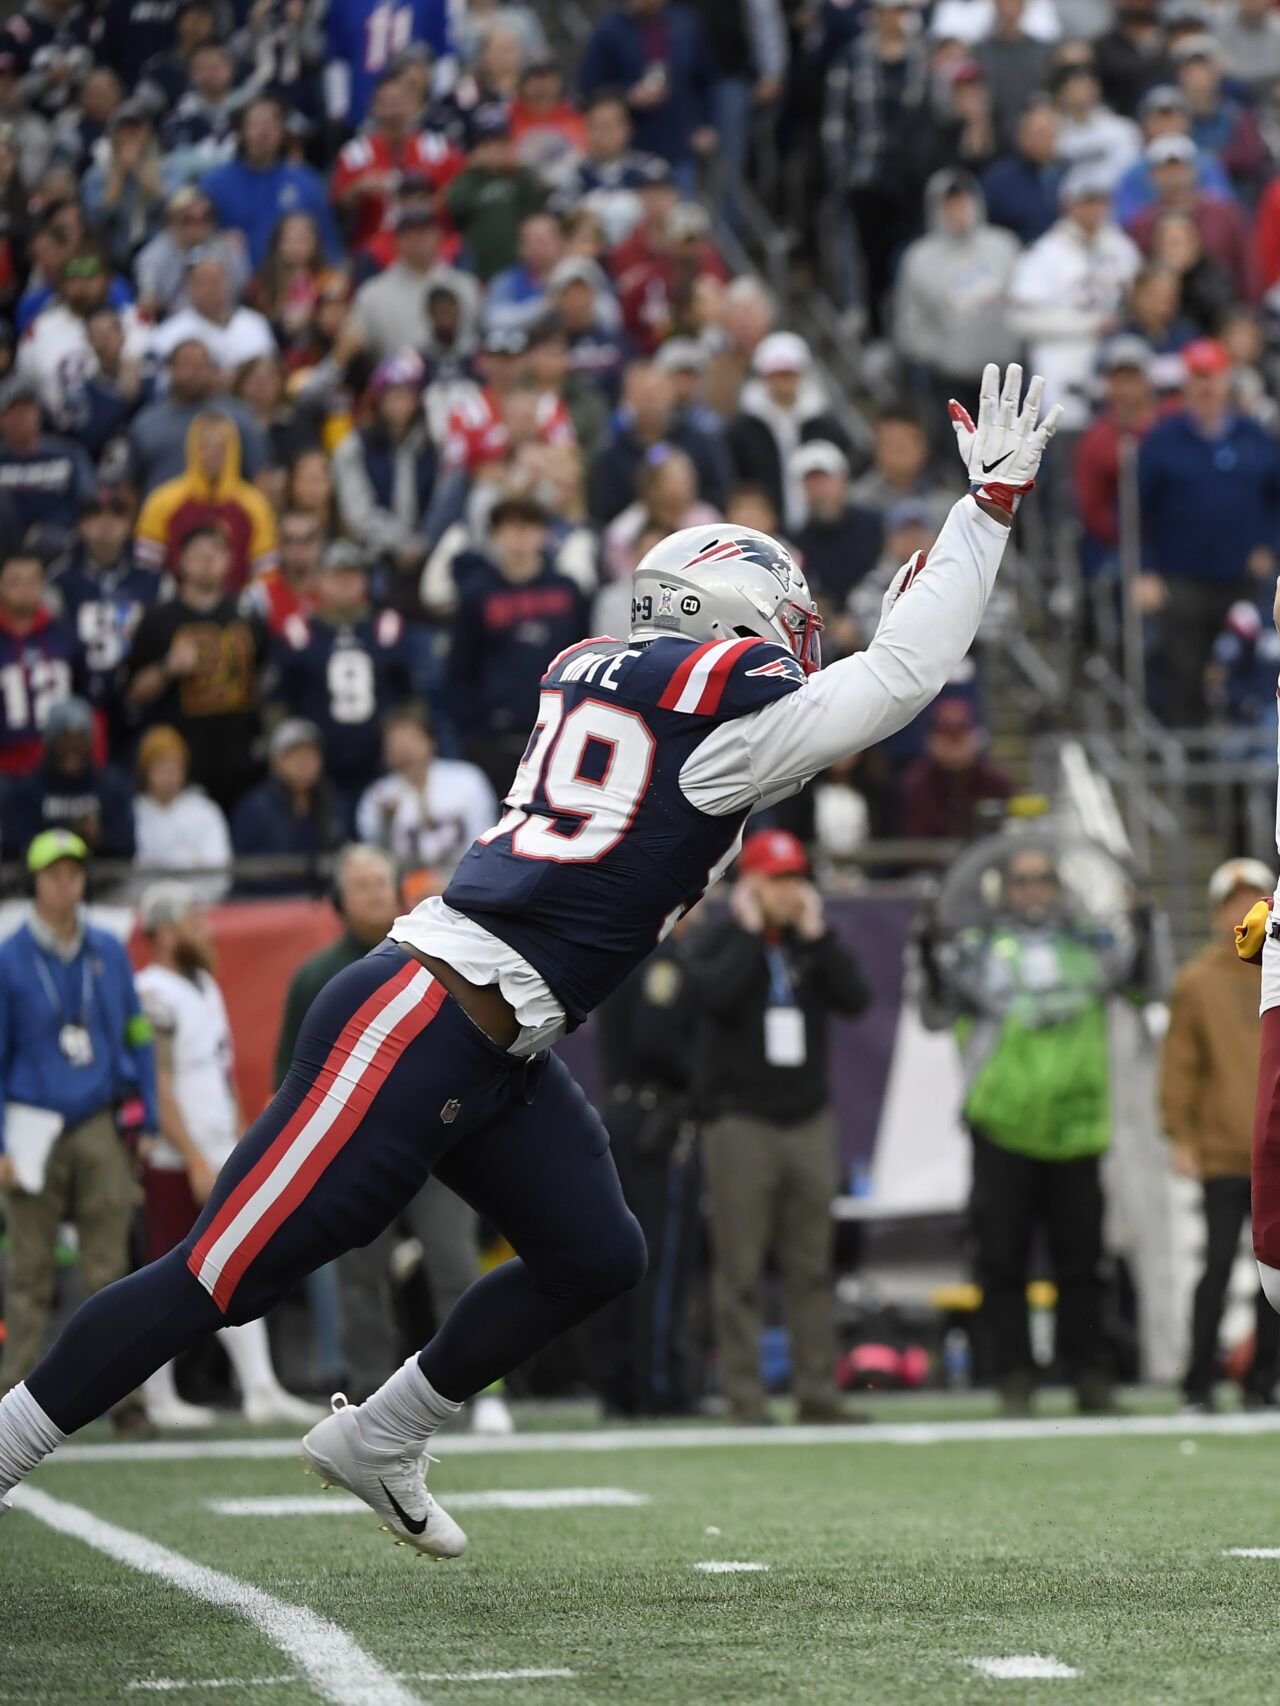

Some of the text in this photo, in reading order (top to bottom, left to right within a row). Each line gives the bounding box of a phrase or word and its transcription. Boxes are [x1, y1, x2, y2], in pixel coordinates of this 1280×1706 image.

[682, 598, 699, 612] CD
[326, 649, 376, 724] 9
[479, 688, 658, 864] 99
